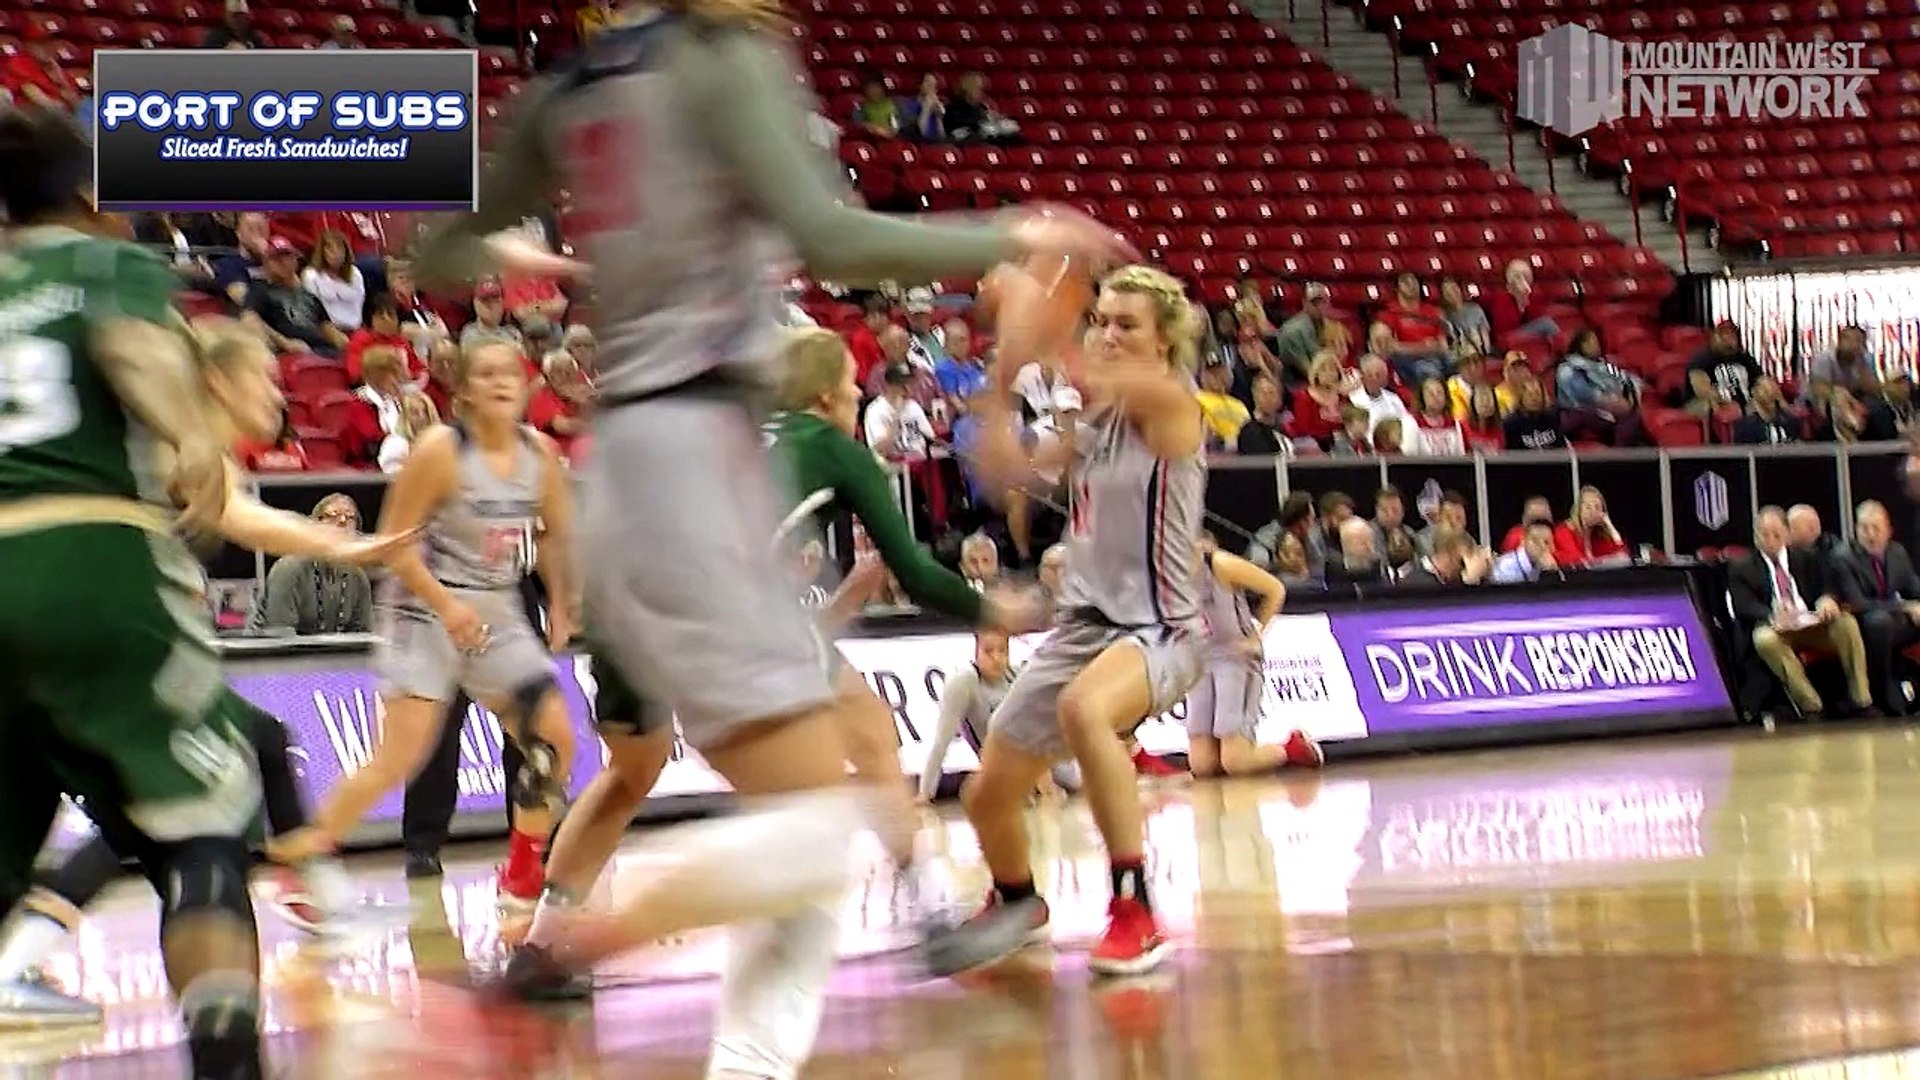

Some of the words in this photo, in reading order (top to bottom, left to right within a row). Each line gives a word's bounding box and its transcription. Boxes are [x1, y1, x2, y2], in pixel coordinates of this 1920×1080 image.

[1365, 635, 1533, 703] DRINK
[1522, 626, 1697, 691] RESPONSIBLY
[457, 765, 506, 796] BREW
